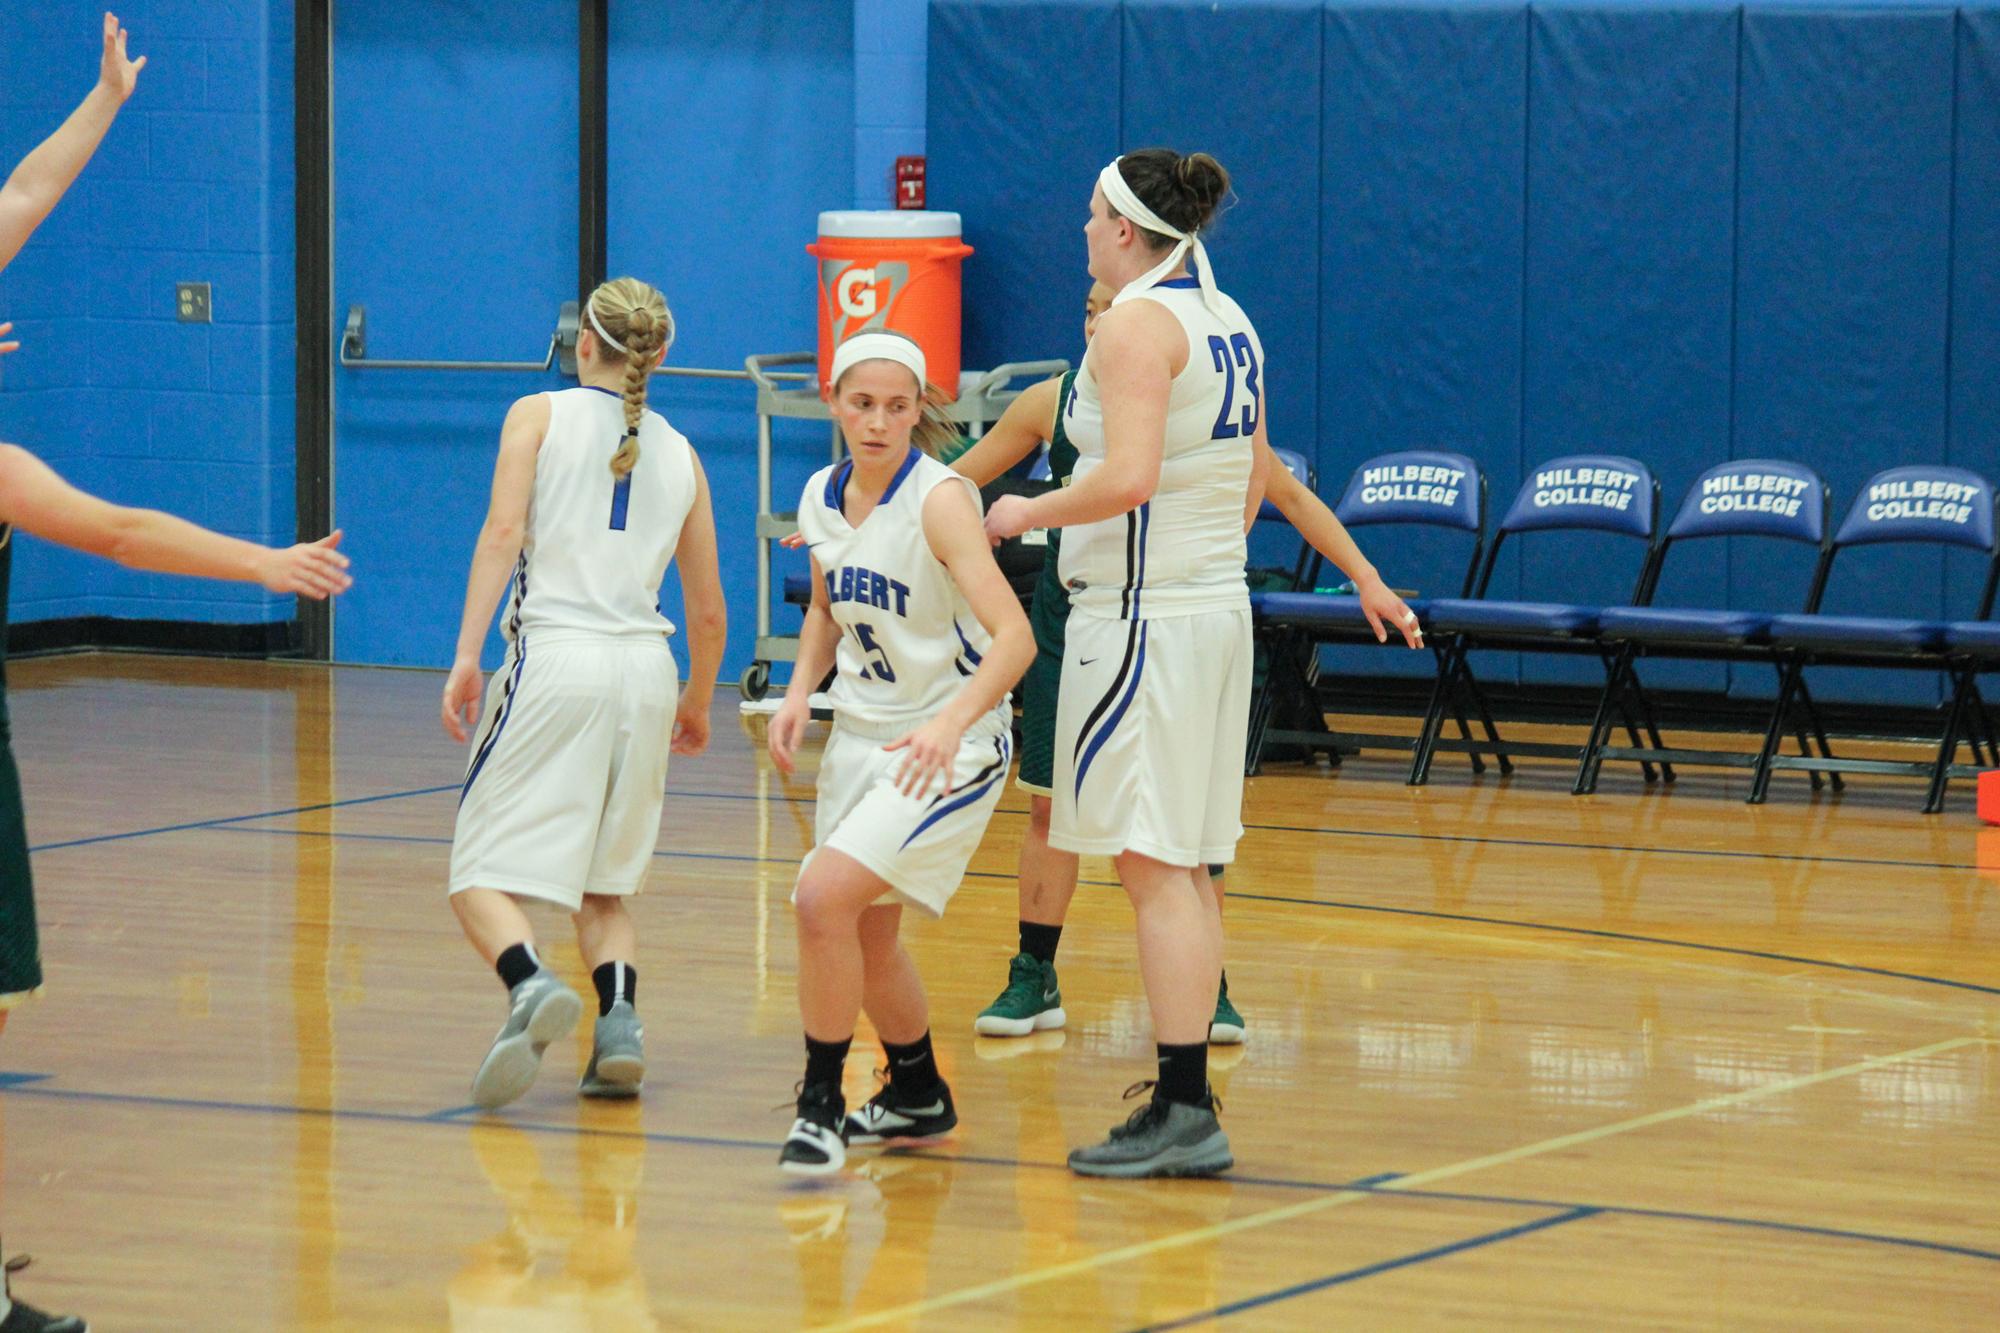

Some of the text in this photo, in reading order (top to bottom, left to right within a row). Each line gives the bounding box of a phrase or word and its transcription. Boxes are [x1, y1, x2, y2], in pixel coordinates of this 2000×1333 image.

[838, 268, 876, 317] G
[1207, 332, 1260, 440] 23
[608, 435, 633, 531] 1
[1363, 465, 1465, 487] HILBERT
[1536, 468, 1640, 491] HILBERT
[1703, 474, 1809, 498] HILBERT
[1361, 484, 1459, 507] COLLEGE
[1533, 488, 1633, 511] COLLEGE
[1869, 480, 1980, 504] HILBERT
[1700, 494, 1803, 518] COLLEGE
[1867, 501, 1973, 525] COLLEGE
